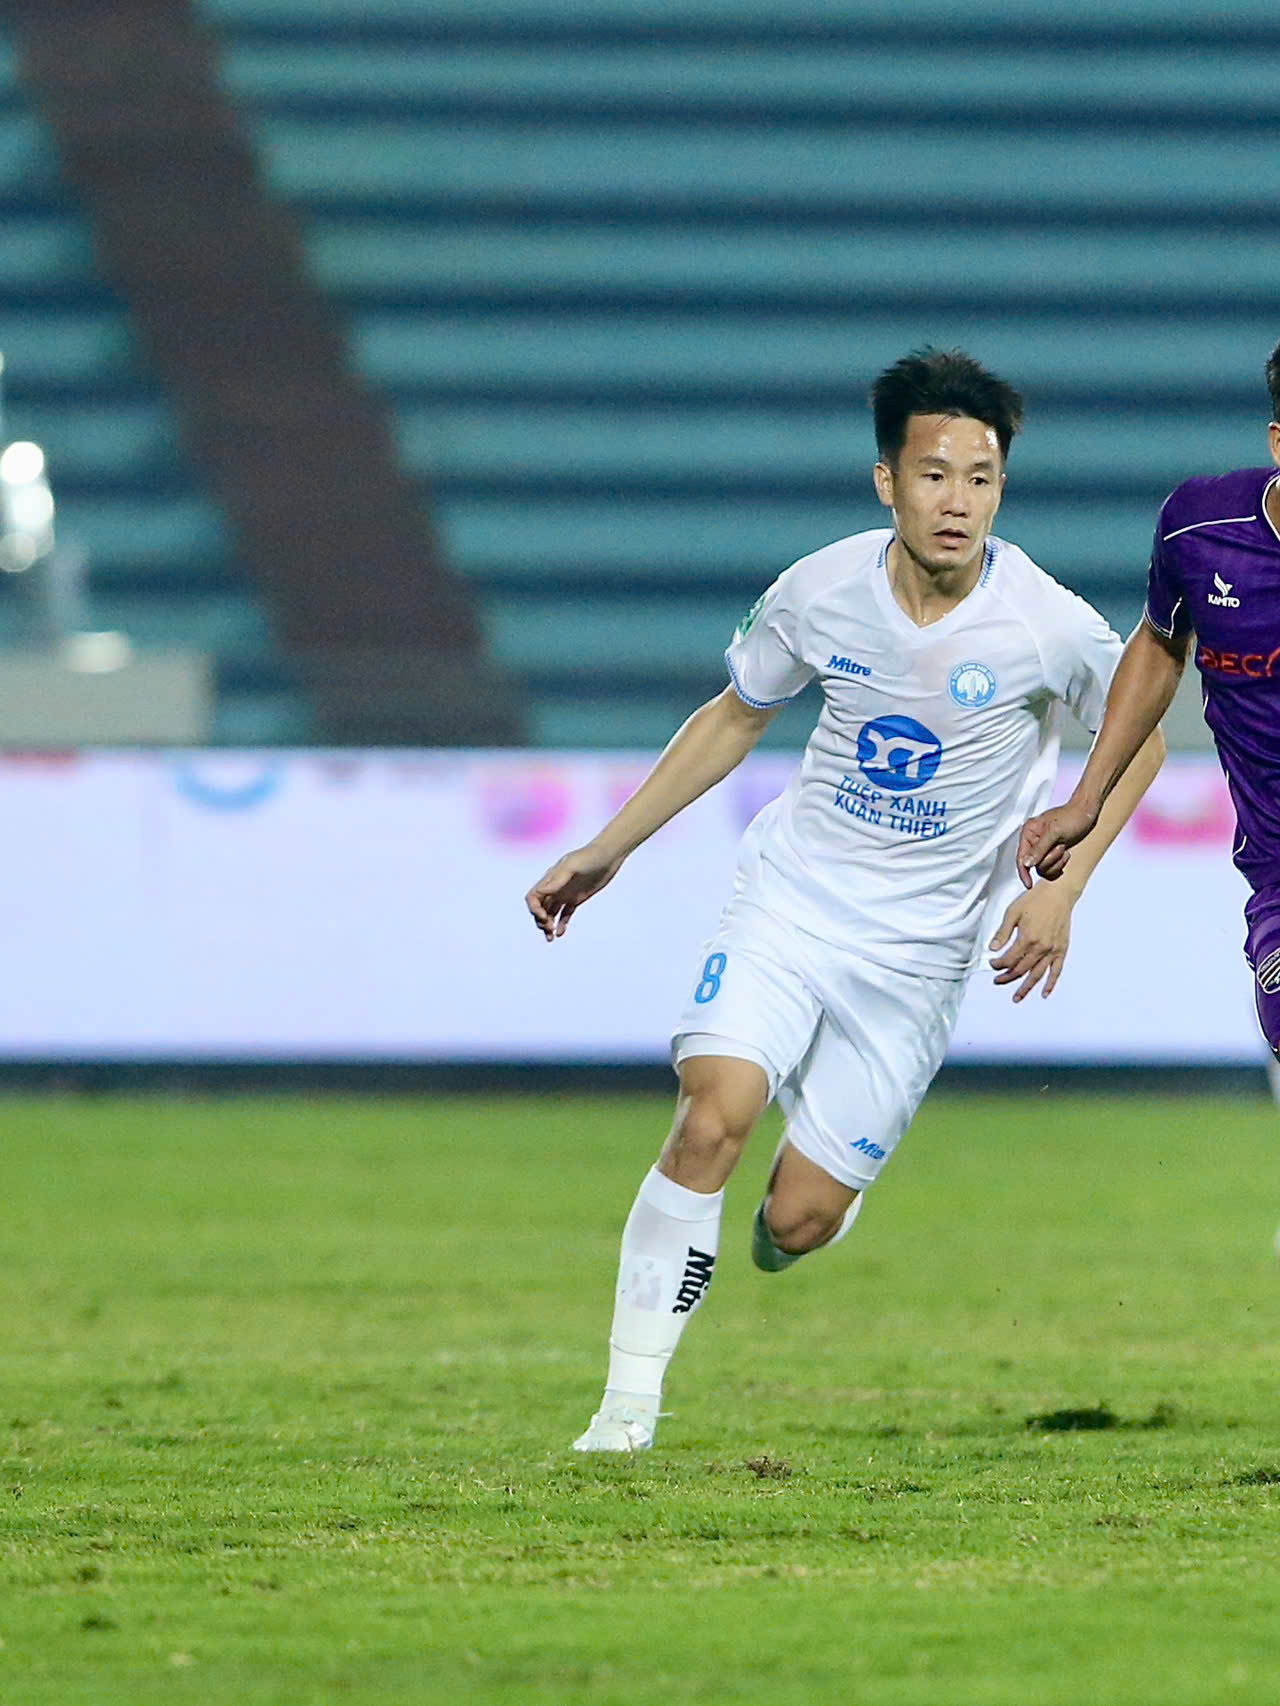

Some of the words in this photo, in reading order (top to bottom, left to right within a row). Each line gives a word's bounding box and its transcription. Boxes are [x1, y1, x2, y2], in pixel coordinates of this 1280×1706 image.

[824, 655, 871, 676] Mitre
[890, 795, 946, 816] XANH
[694, 952, 727, 1004] 8
